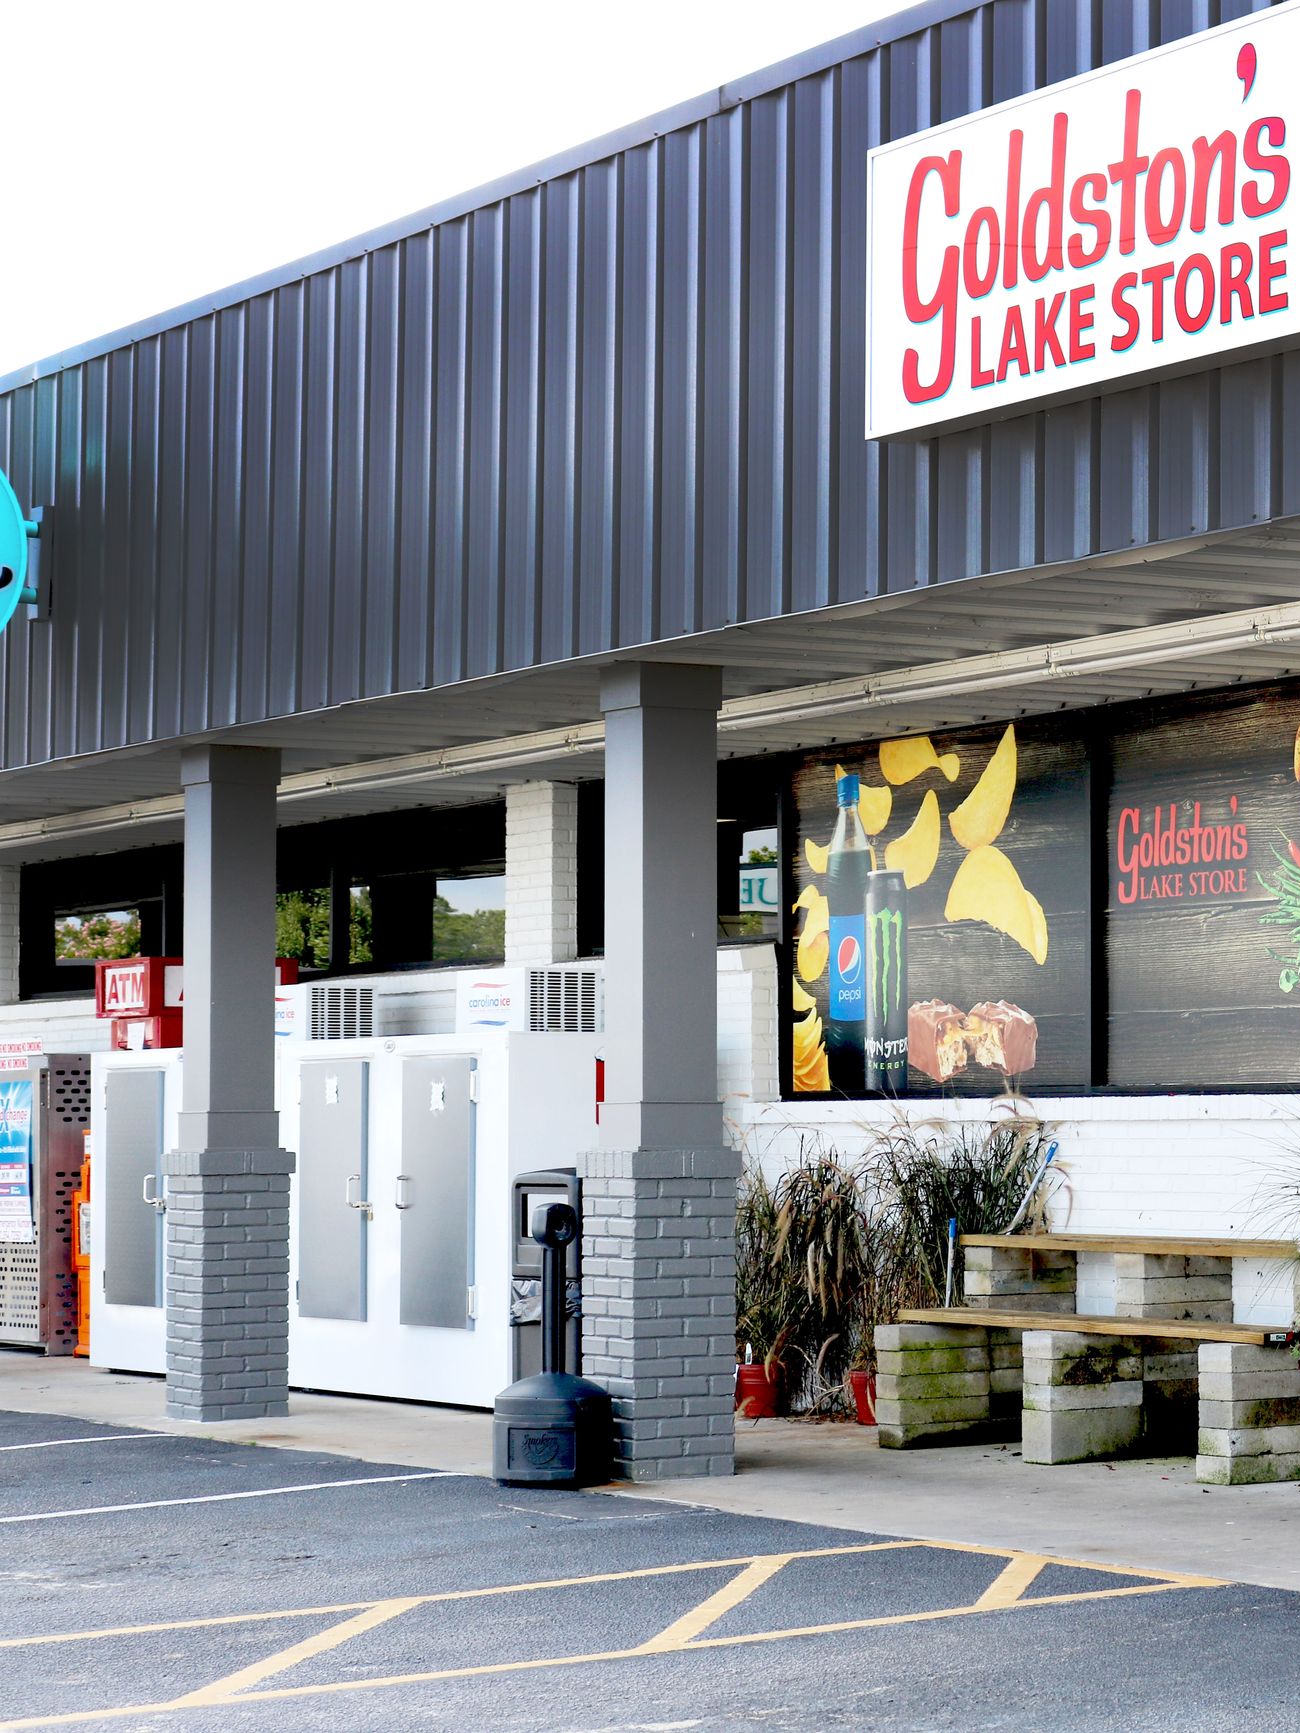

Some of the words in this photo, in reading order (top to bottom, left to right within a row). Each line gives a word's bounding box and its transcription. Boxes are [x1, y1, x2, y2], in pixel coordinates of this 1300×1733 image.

[902, 42, 1291, 404] Goldston's
[971, 283, 1096, 389] LAKE
[1110, 229, 1289, 352] STORE
[1117, 795, 1249, 904] Goldston's
[1139, 872, 1184, 900] LAKE
[1189, 868, 1248, 897] STORE
[107, 972, 144, 1004] ATM
[838, 986, 862, 1003] pepsi
[867, 1059, 905, 1070] ENERGY
